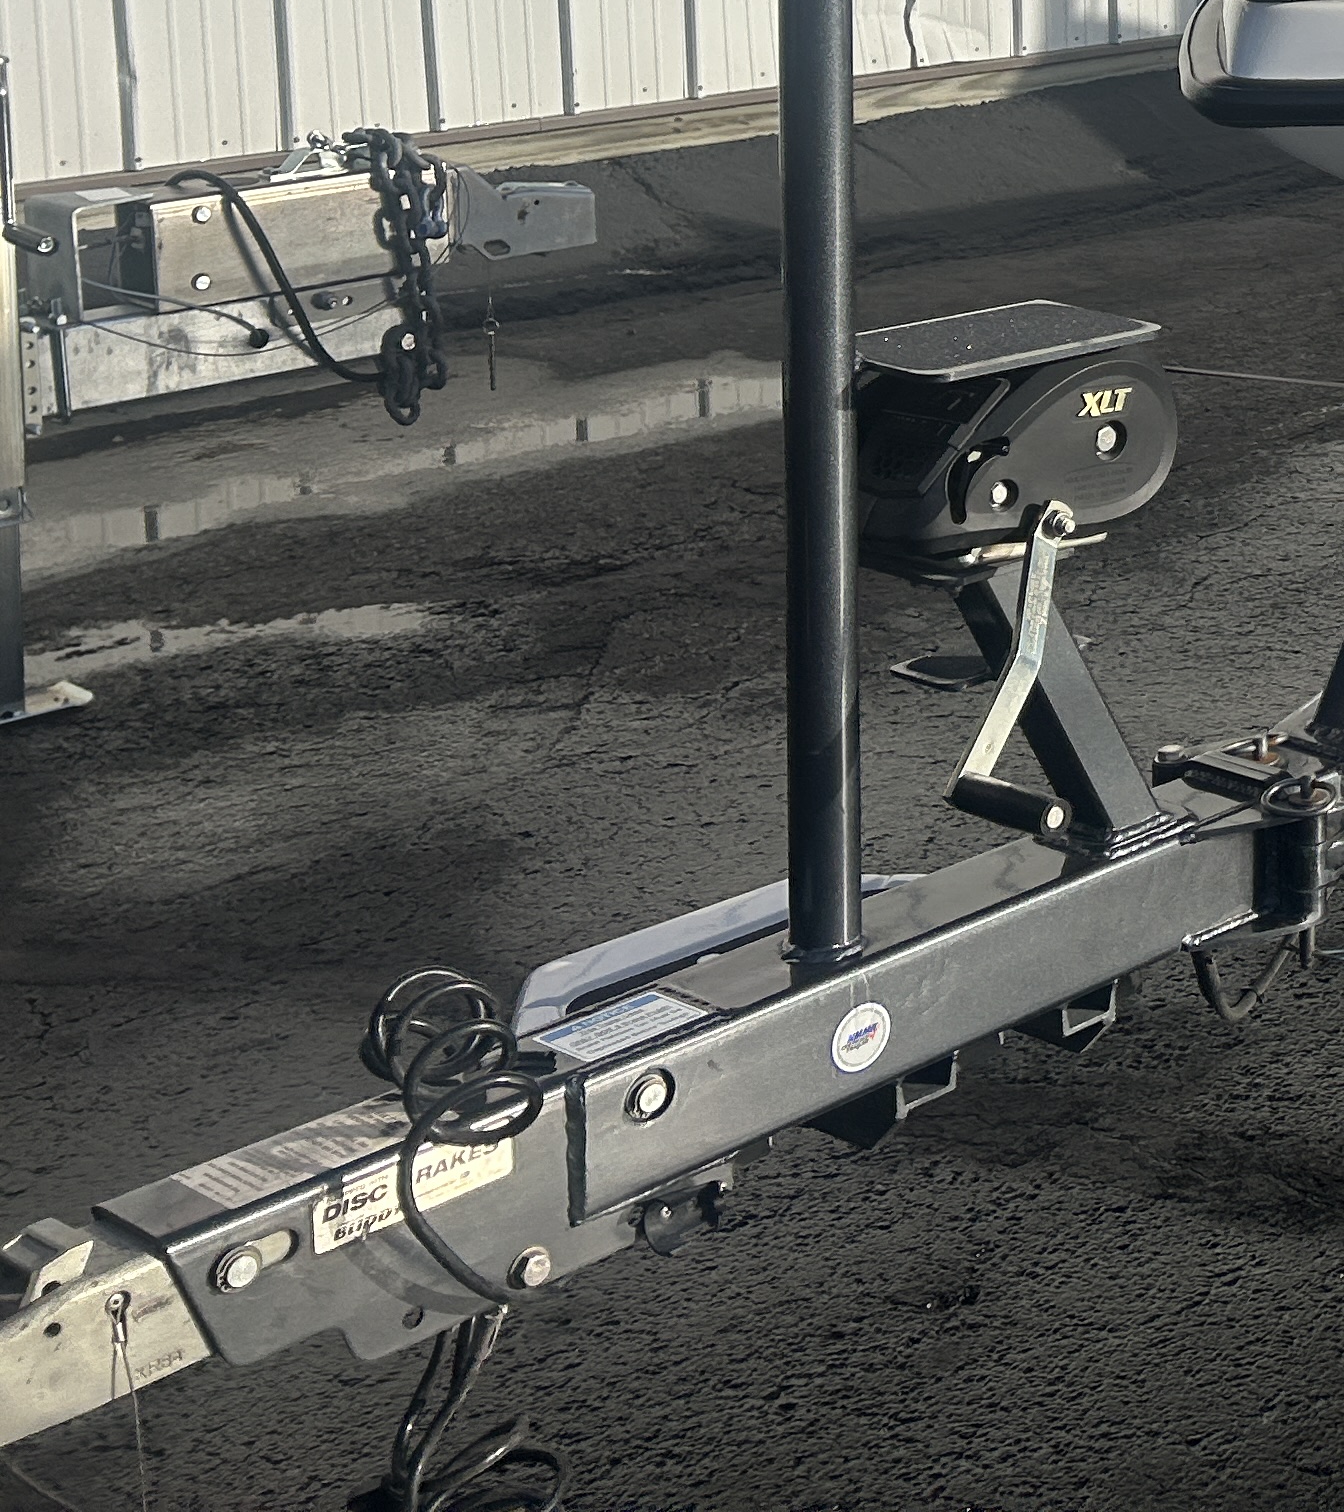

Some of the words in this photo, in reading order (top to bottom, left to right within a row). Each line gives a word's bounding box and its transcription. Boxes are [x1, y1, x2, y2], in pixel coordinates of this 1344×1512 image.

[1076, 387, 1133, 417] XLT
[321, 1183, 389, 1225] DISC
[415, 1143, 499, 1185] RAKES
